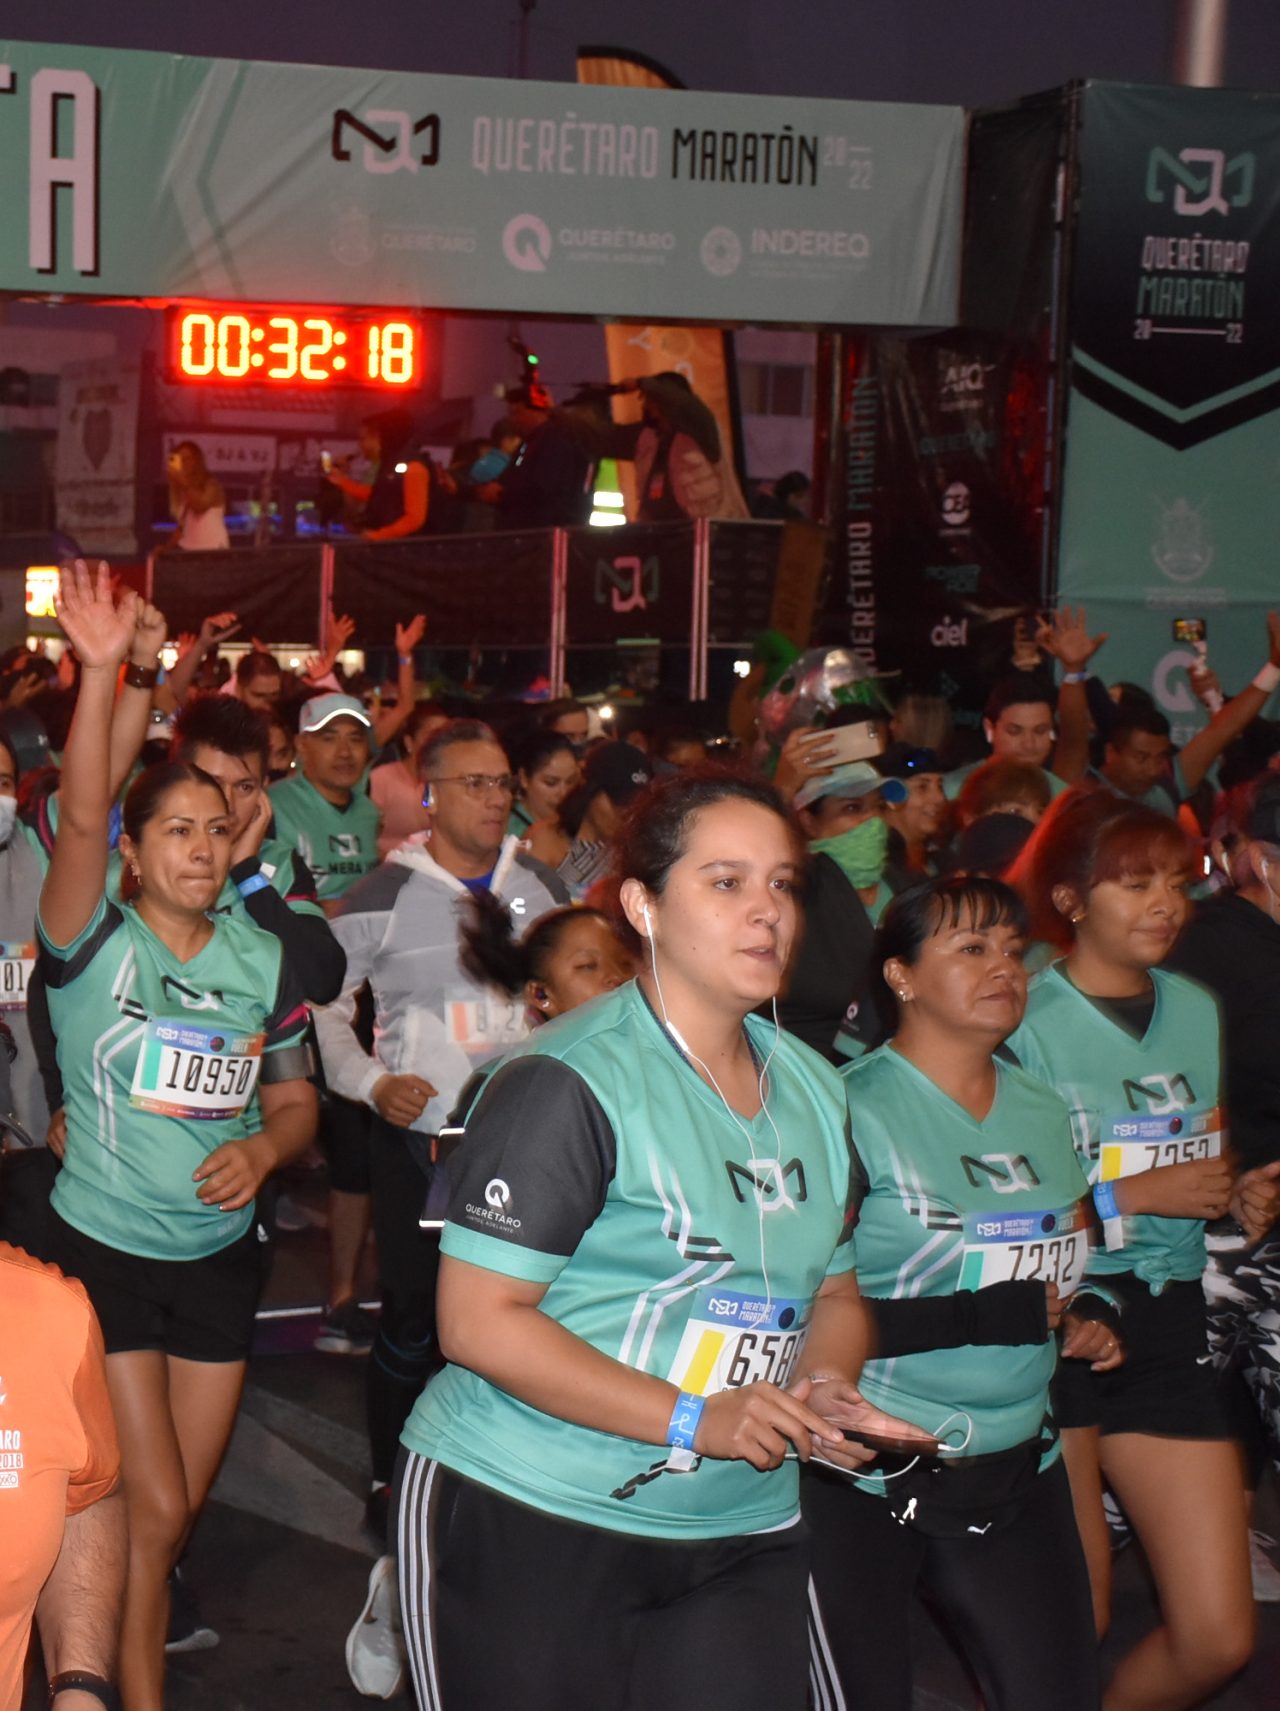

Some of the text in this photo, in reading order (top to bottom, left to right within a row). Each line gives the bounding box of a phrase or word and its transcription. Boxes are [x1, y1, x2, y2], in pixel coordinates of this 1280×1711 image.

[473, 112, 818, 187] QUERÉTARO MARATÓN
[558, 227, 677, 252] QUERÉTARO
[750, 228, 870, 259] INDEREQ
[1141, 233, 1250, 273] QUERÉTARO
[1136, 272, 1245, 319] MARATÓN
[846, 522, 878, 673] UERÉTARO
[931, 616, 968, 647] ciel
[166, 1050, 253, 1096] 10950
[465, 1203, 521, 1229] QUERÉTARO
[1008, 1237, 1076, 1283] 7232
